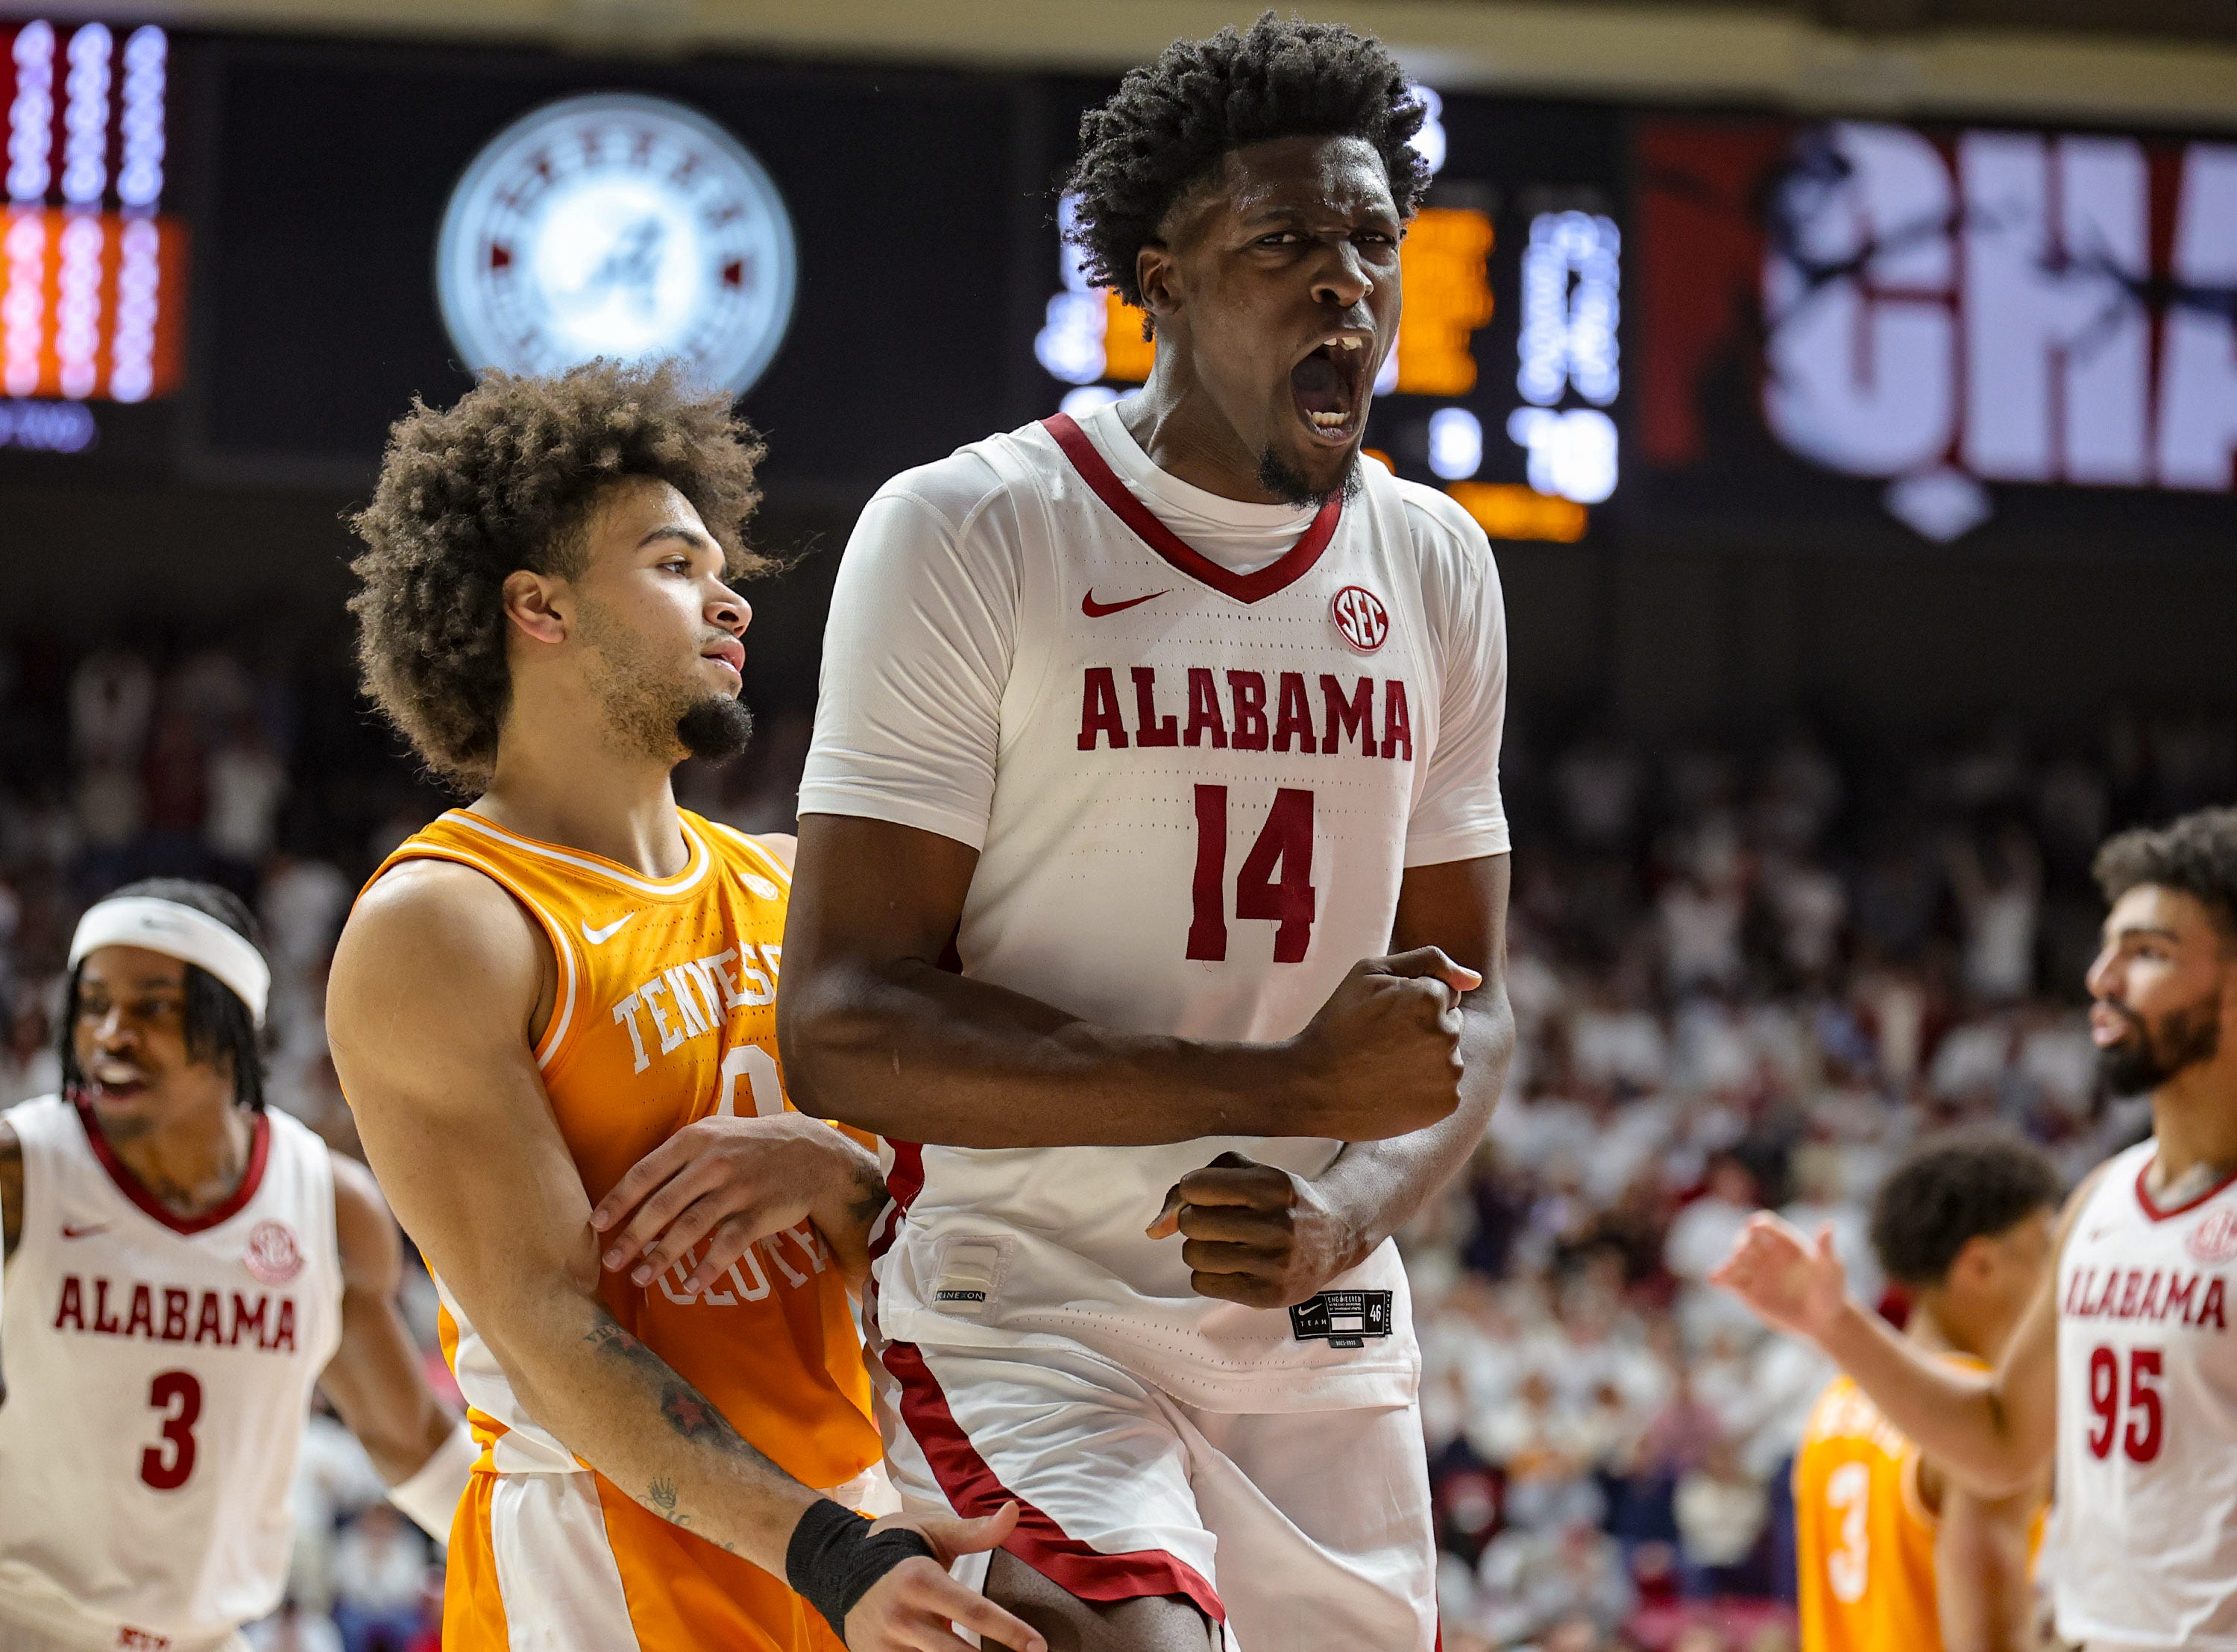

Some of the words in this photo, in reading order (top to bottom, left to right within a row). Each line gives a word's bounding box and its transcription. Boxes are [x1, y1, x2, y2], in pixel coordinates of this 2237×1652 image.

[1337, 589, 1385, 646] SEC
[1077, 667, 1412, 761] ALABAMA
[1186, 784, 1315, 963] 14
[55, 1276, 297, 1352] ALABAMA
[1300, 1319, 1327, 1327] TEAM
[1370, 1304, 1381, 1322] 46
[142, 1370, 201, 1490] 3
[2089, 1347, 2162, 1463] 95
[1825, 1461, 1871, 1604] 3
